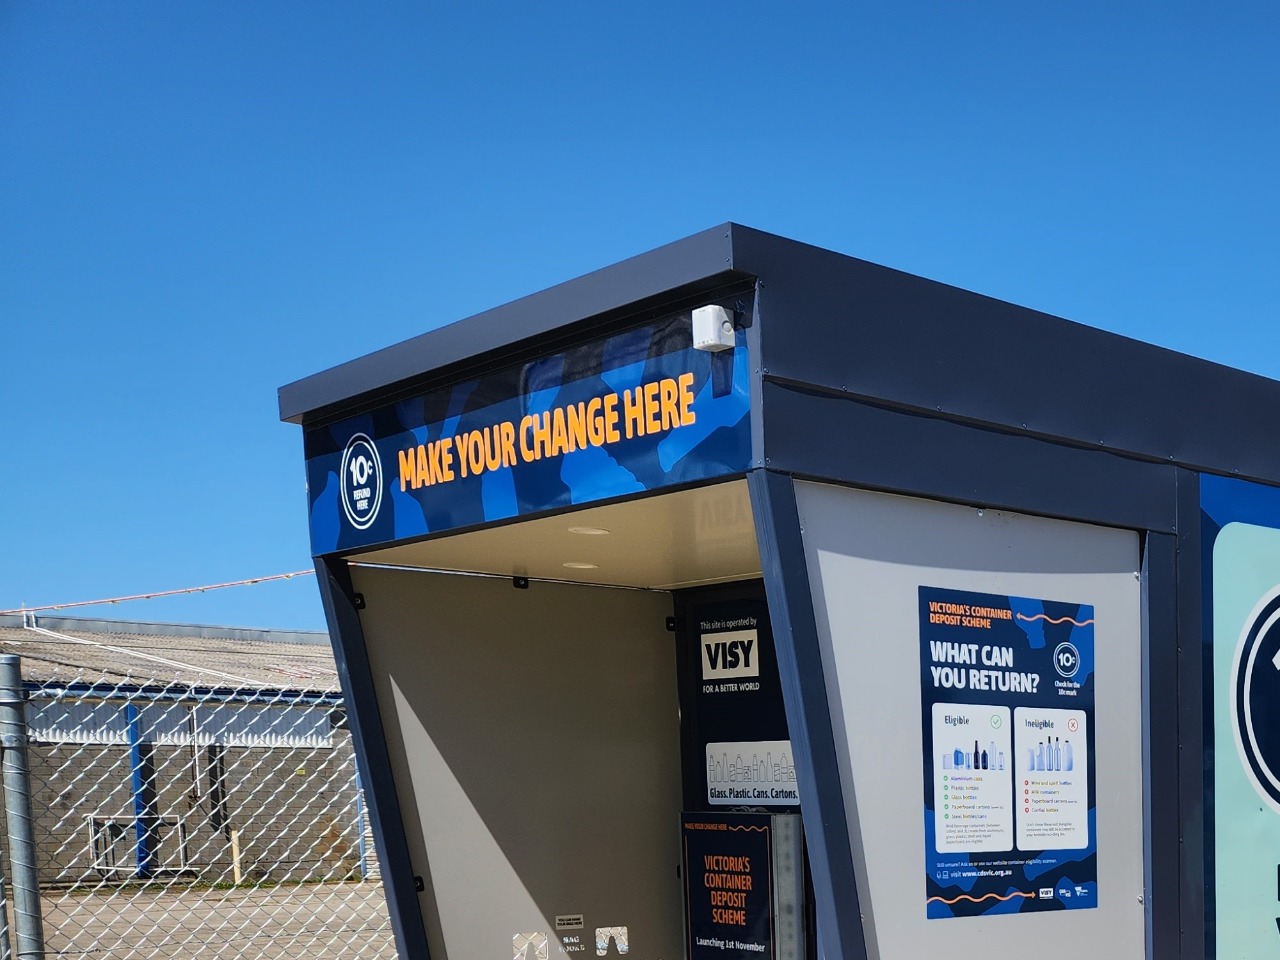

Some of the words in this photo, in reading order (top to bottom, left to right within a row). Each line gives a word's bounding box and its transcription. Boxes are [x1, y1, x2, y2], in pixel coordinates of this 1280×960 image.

[398, 439, 455, 493] MAKE
[456, 421, 517, 478] YOUR
[519, 393, 620, 463] CHANGE
[624, 372, 696, 440] HERE
[353, 487, 371, 500] REFUND
[356, 499, 369, 511] HERE
[929, 602, 970, 616] VICTORIA'S
[971, 606, 1012, 620] CONTAINER
[700, 621, 711, 630] This
[711, 621, 721, 629] site
[721, 620, 726, 628] is
[726, 618, 748, 629] operated
[748, 617, 757, 627] by
[930, 615, 961, 626] DEPOSIT
[961, 617, 992, 629] SCHEME
[705, 640, 754, 671] VISY
[930, 640, 978, 664] WHAT
[981, 646, 1014, 668] CAN
[930, 666, 966, 689] YOU
[969, 669, 1040, 693] RETURN?
[703, 685, 714, 693] FOR
[714, 685, 720, 693] A
[720, 683, 738, 692] BETTER
[738, 682, 760, 692] WORLD
[945, 715, 970, 725] Eligible
[1025, 719, 1054, 730] Ineligible
[709, 788, 729, 799] Glass.
[729, 787, 752, 799] Plastic.
[752, 787, 770, 799] Cans.
[770, 787, 798, 799] Cartons.
[704, 823, 718, 831] CHANGE
[718, 823, 727, 831] HERE
[704, 855, 751, 873] VICTORIA'S
[704, 873, 752, 890] CONTAINER
[962, 870, 1012, 878] www.cdsvic.org.au
[710, 890, 747, 908] DEPOSIT
[712, 908, 747, 926] SCHEME
[696, 936, 724, 950] Launching
[725, 938, 734, 949] 1st
[735, 938, 765, 953] November
